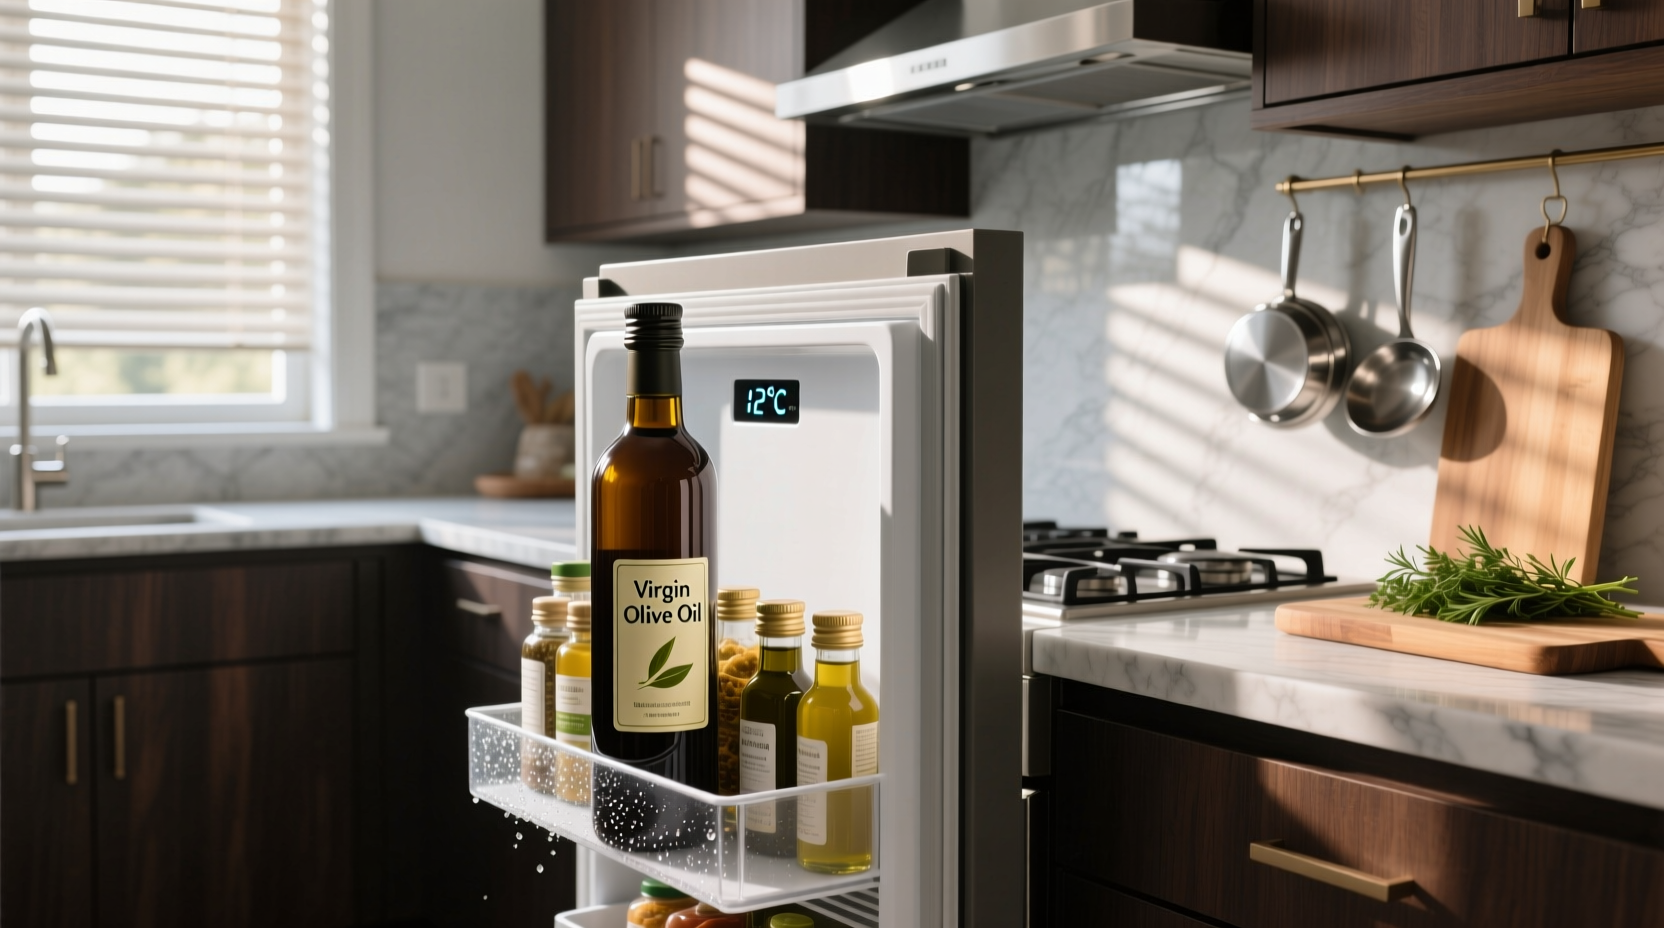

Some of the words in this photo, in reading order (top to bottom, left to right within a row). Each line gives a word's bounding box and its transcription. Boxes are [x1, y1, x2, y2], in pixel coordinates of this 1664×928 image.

[747, 386, 787, 415] 12°C
[633, 579, 690, 604] Virgin
[623, 604, 673, 624] Olive
[677, 602, 701, 623] Oil
